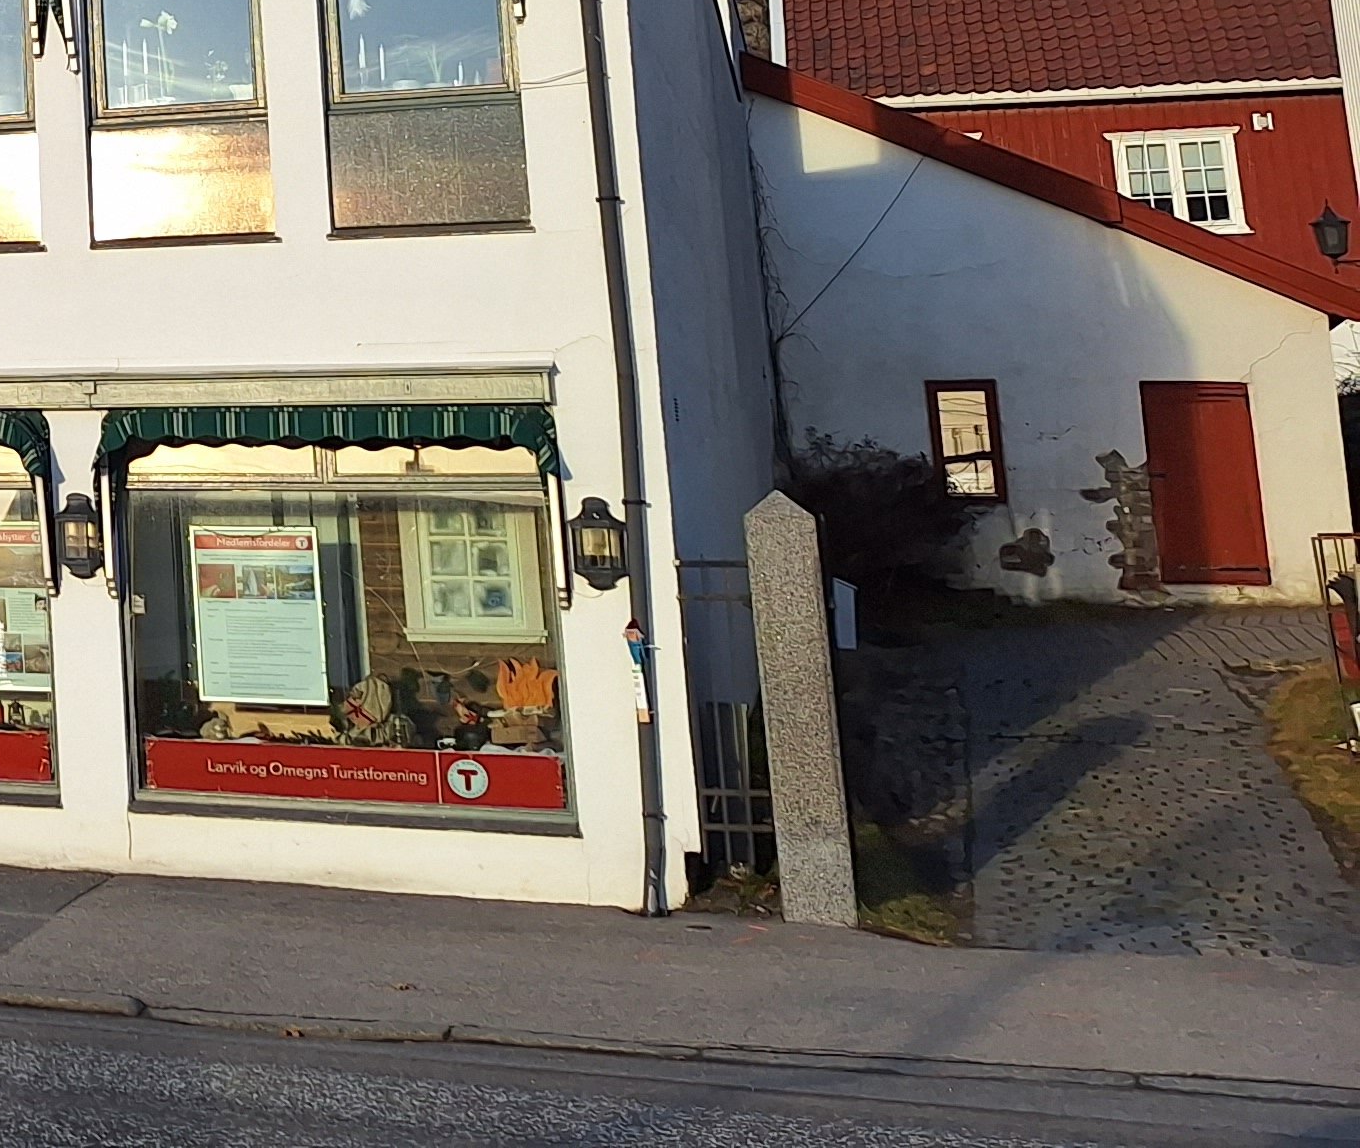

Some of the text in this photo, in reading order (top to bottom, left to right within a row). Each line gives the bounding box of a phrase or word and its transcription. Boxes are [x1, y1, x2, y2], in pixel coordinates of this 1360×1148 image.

[207, 758, 248, 774] Larvik
[250, 763, 267, 778] og
[269, 761, 328, 781] Omegns
[330, 764, 428, 786] Turistforening
